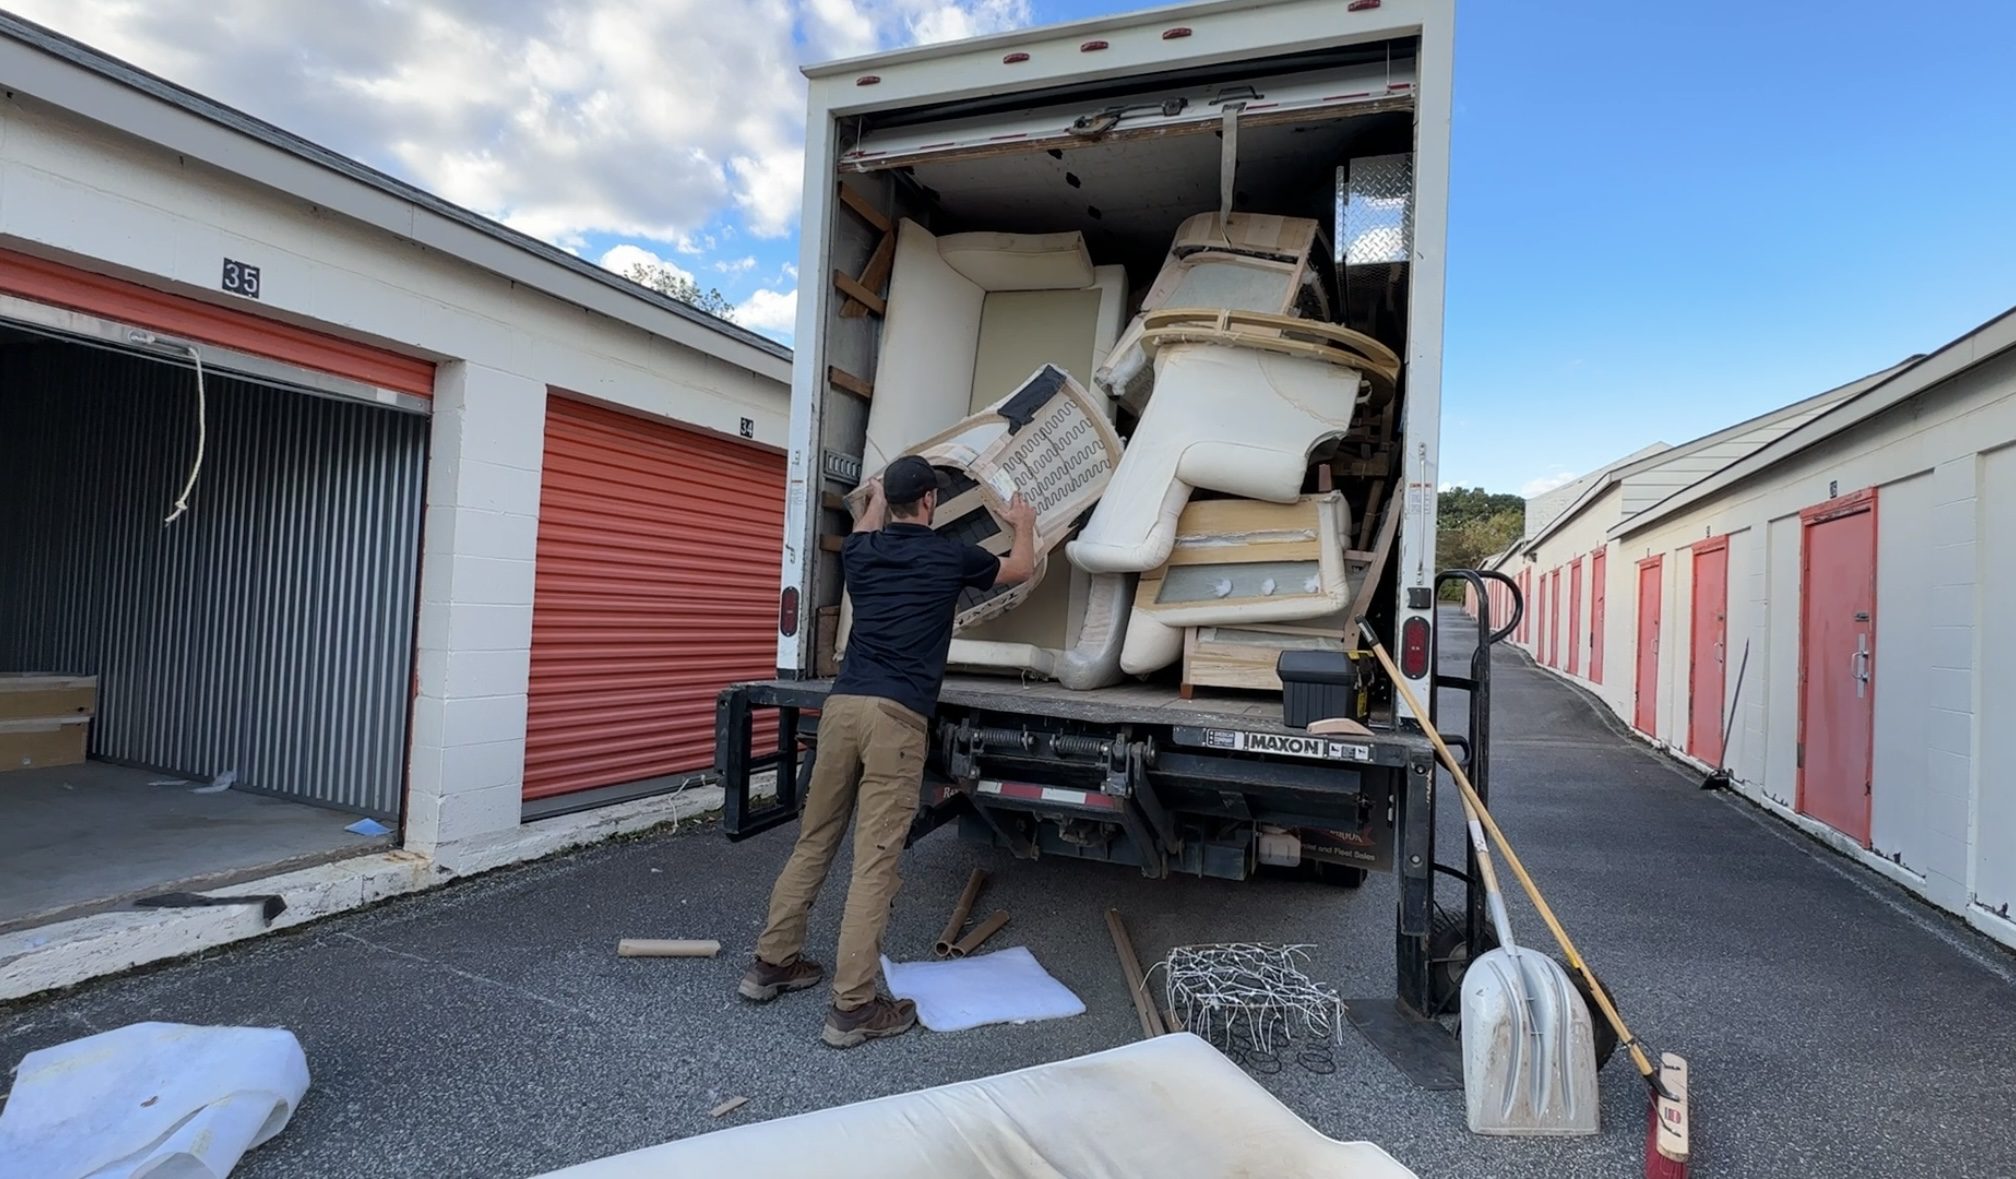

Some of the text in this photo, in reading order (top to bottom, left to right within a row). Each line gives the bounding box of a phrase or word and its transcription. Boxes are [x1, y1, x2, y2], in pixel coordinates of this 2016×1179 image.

[225, 263, 257, 293] 35
[740, 419, 753, 437] 34
[1250, 735, 1319, 755] MAXON
